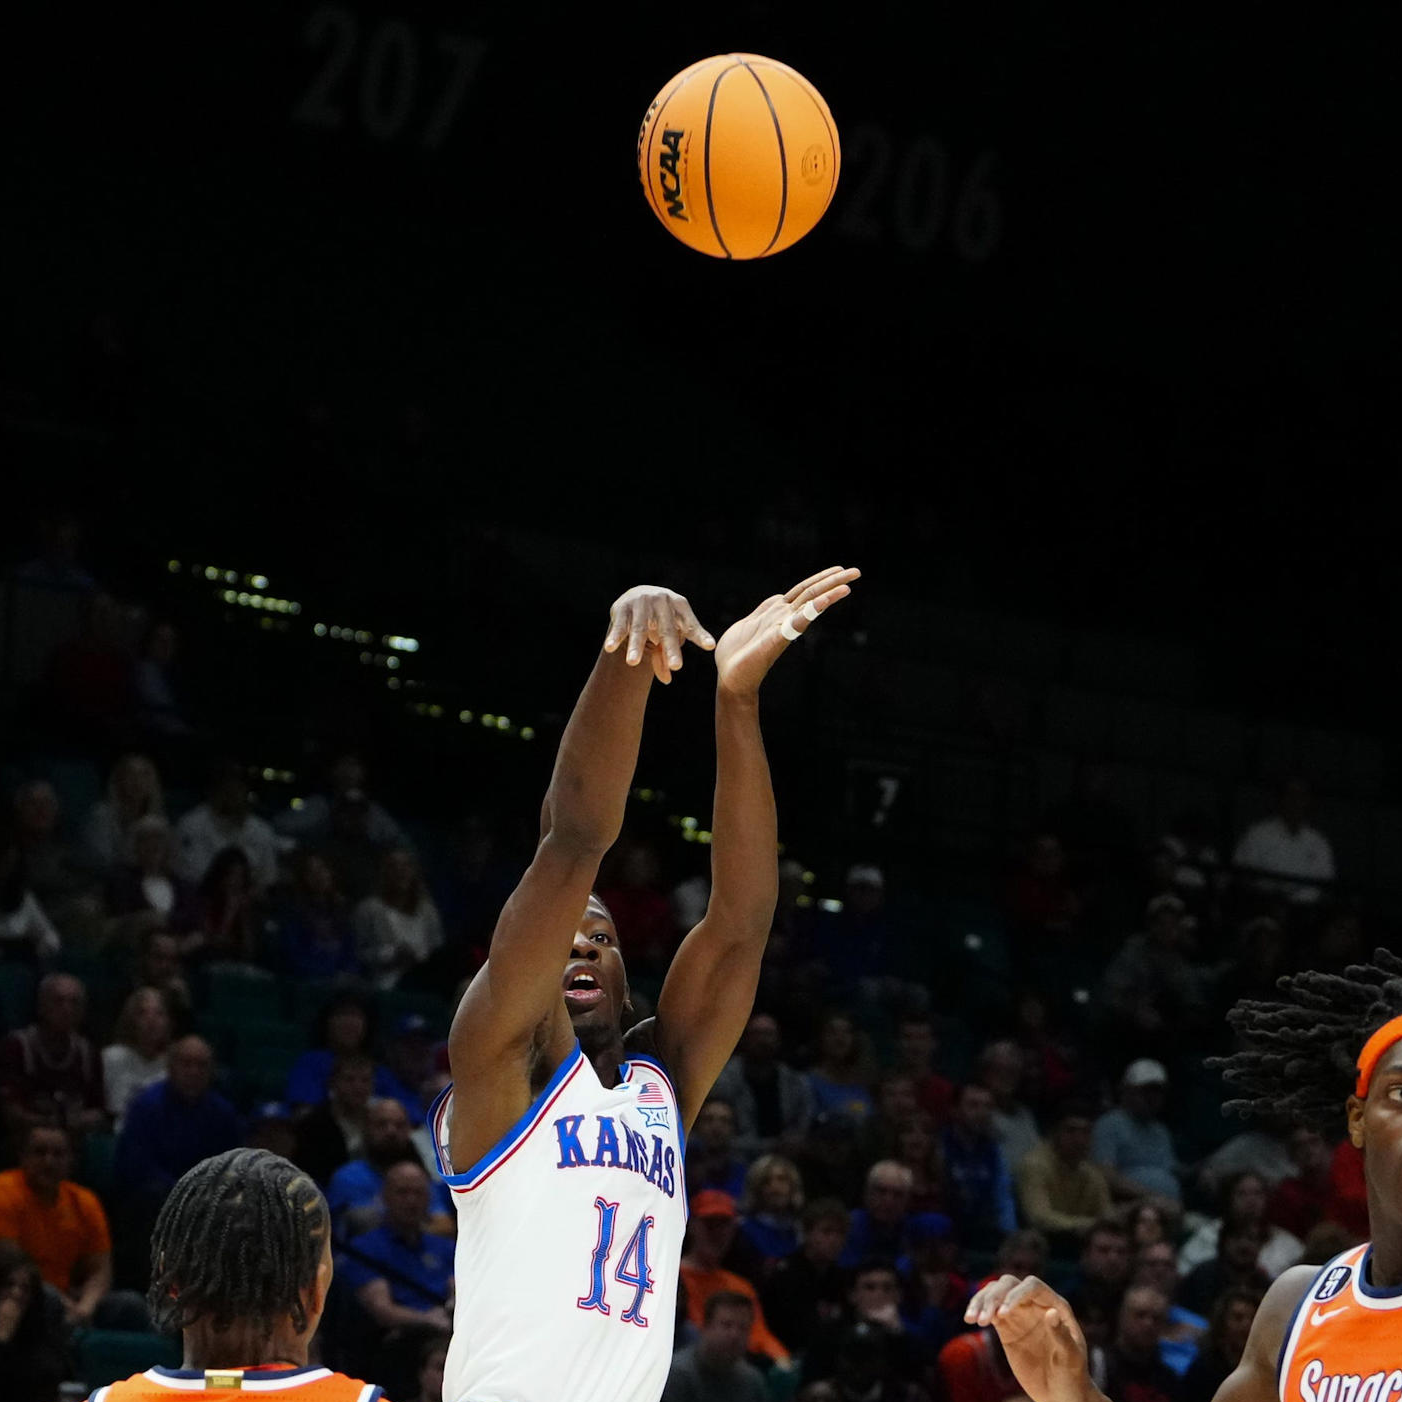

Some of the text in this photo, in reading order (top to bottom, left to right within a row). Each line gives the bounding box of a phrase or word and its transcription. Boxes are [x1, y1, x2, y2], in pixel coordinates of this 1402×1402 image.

[288, 2, 496, 153] 207
[659, 129, 690, 223] NCAA
[835, 121, 1007, 266] 206
[577, 1196, 655, 1328] 14
